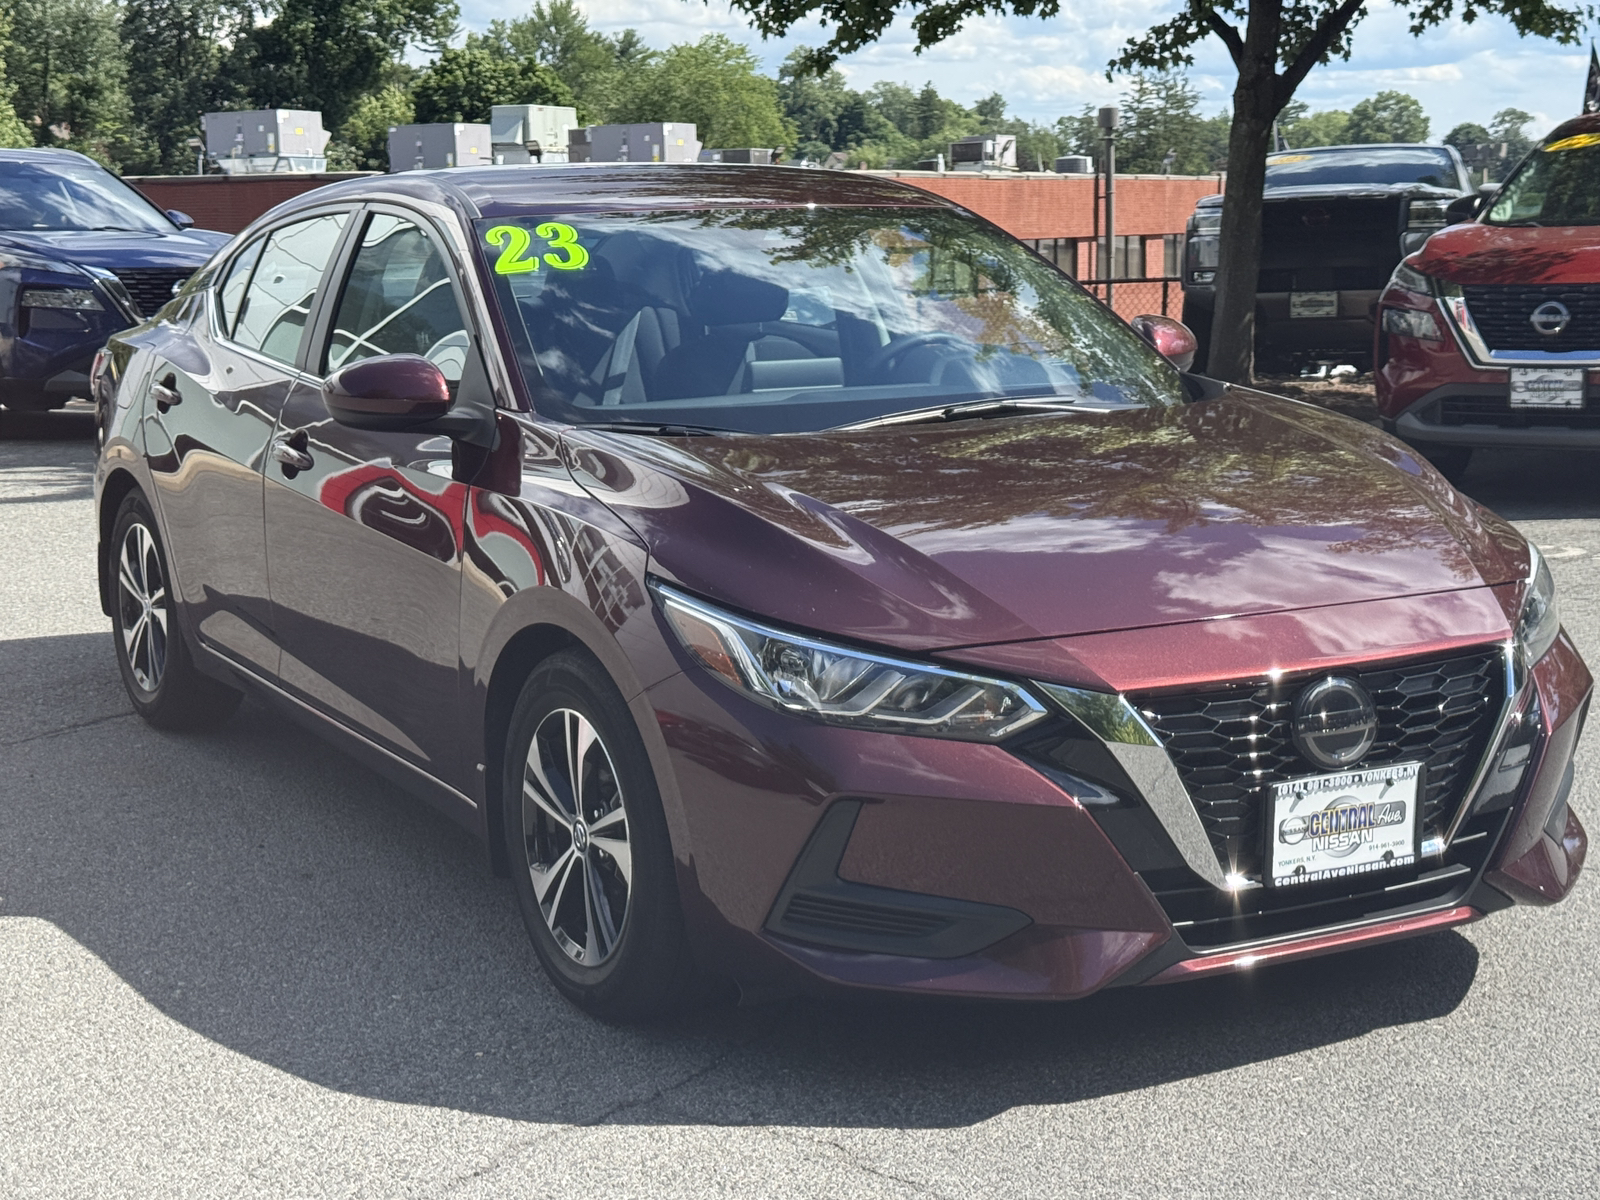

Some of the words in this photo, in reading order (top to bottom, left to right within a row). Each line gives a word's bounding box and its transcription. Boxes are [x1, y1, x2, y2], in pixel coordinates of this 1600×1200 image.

[485, 222, 590, 275] 23
[1310, 803, 1376, 838] CENTRAL
[1312, 829, 1373, 852] NISSAN
